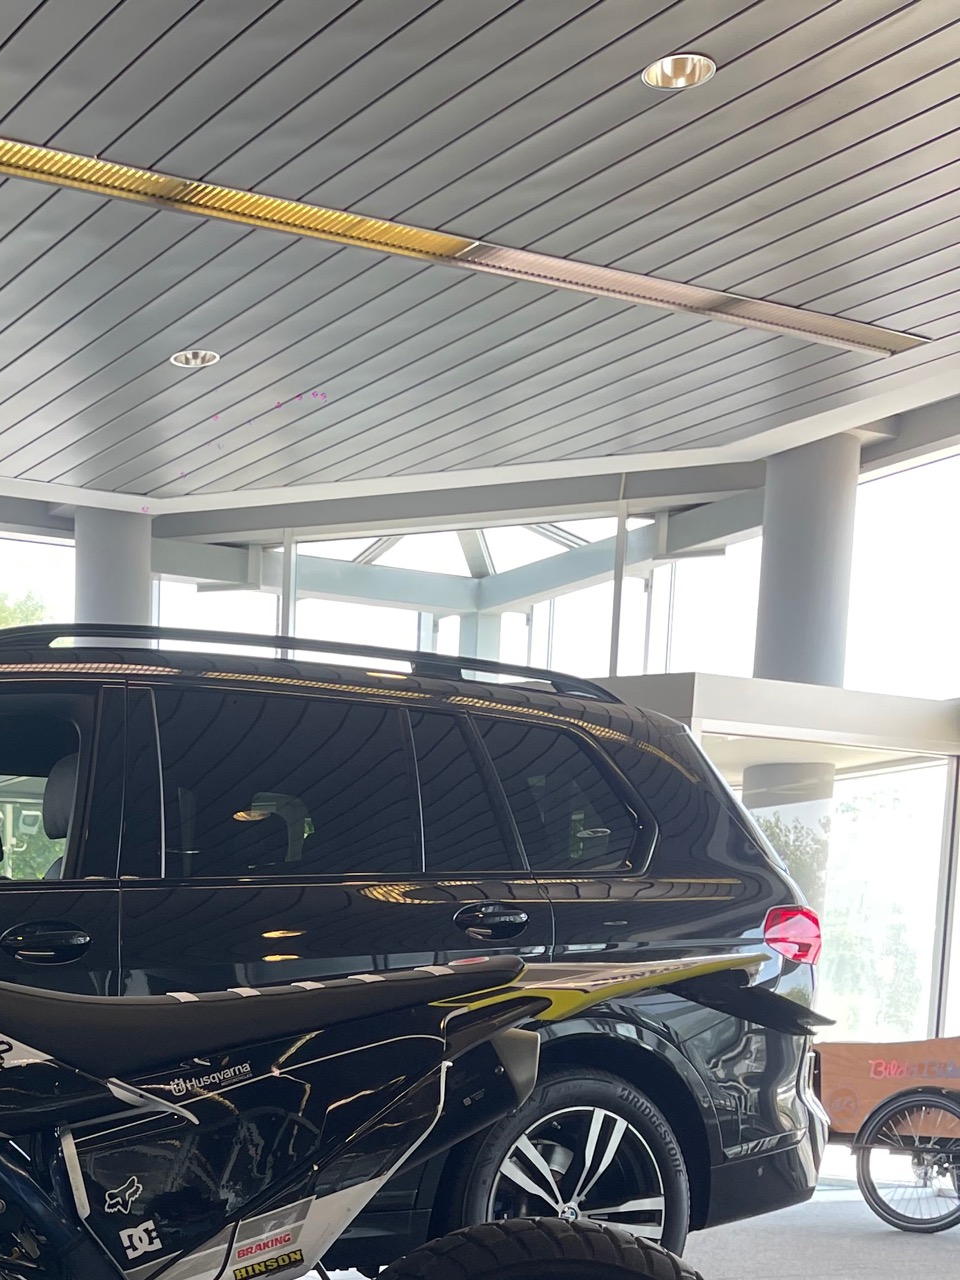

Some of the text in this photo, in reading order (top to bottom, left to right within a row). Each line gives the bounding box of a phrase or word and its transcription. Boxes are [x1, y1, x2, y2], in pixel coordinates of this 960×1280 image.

[185, 1062, 252, 1091] Husqvarna
[618, 1086, 686, 1179] BRIDGESTONE
[119, 1219, 163, 1260] DC
[236, 1233, 291, 1260] BRAKING
